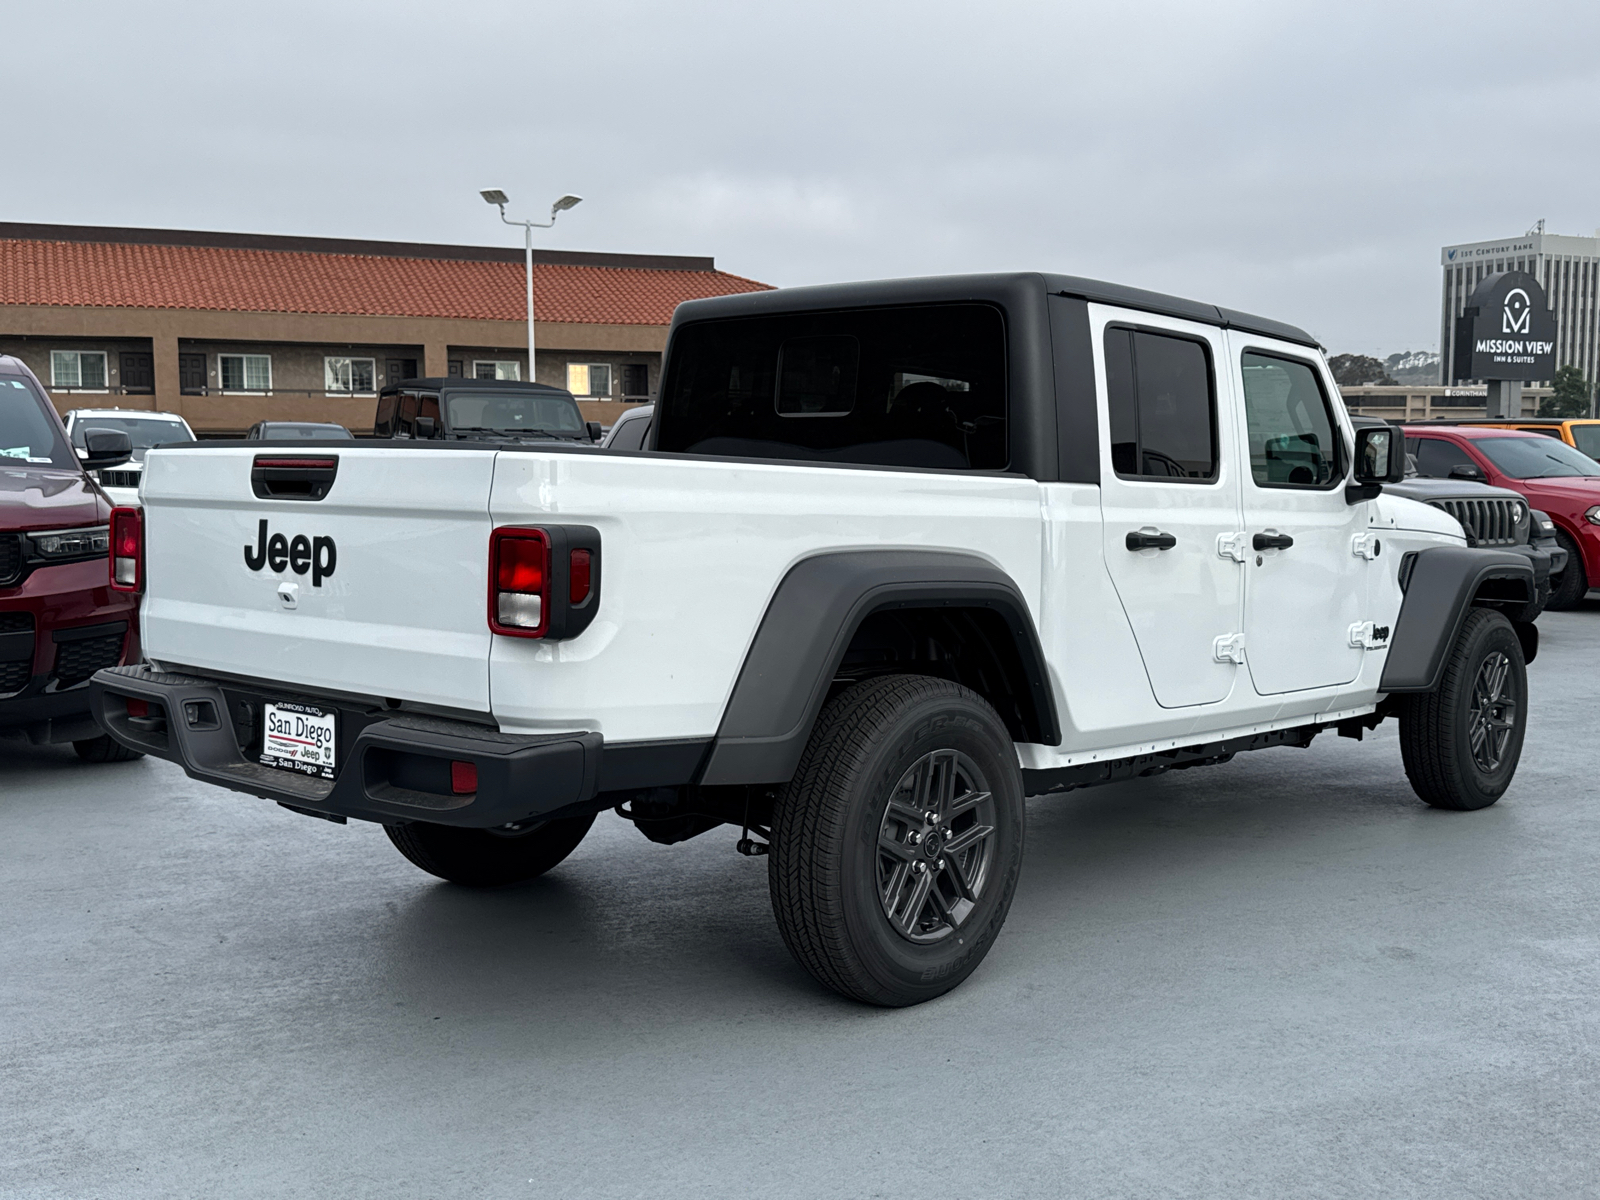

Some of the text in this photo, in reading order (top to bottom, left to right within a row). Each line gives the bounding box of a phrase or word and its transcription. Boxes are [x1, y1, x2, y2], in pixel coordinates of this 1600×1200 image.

[1476, 246, 1510, 256] CENTURY
[1513, 243, 1533, 251] BANK
[1476, 340, 1554, 355] MISSION VIEW
[1493, 355, 1535, 364] INN & SUITES
[243, 518, 337, 588] Jeep
[1372, 624, 1389, 642] Jeep
[304, 707, 320, 715] AUTO
[269, 712, 332, 748] San Diego
[301, 746, 320, 762] Jeep
[278, 758, 293, 768] San
[294, 761, 318, 774] Diego
